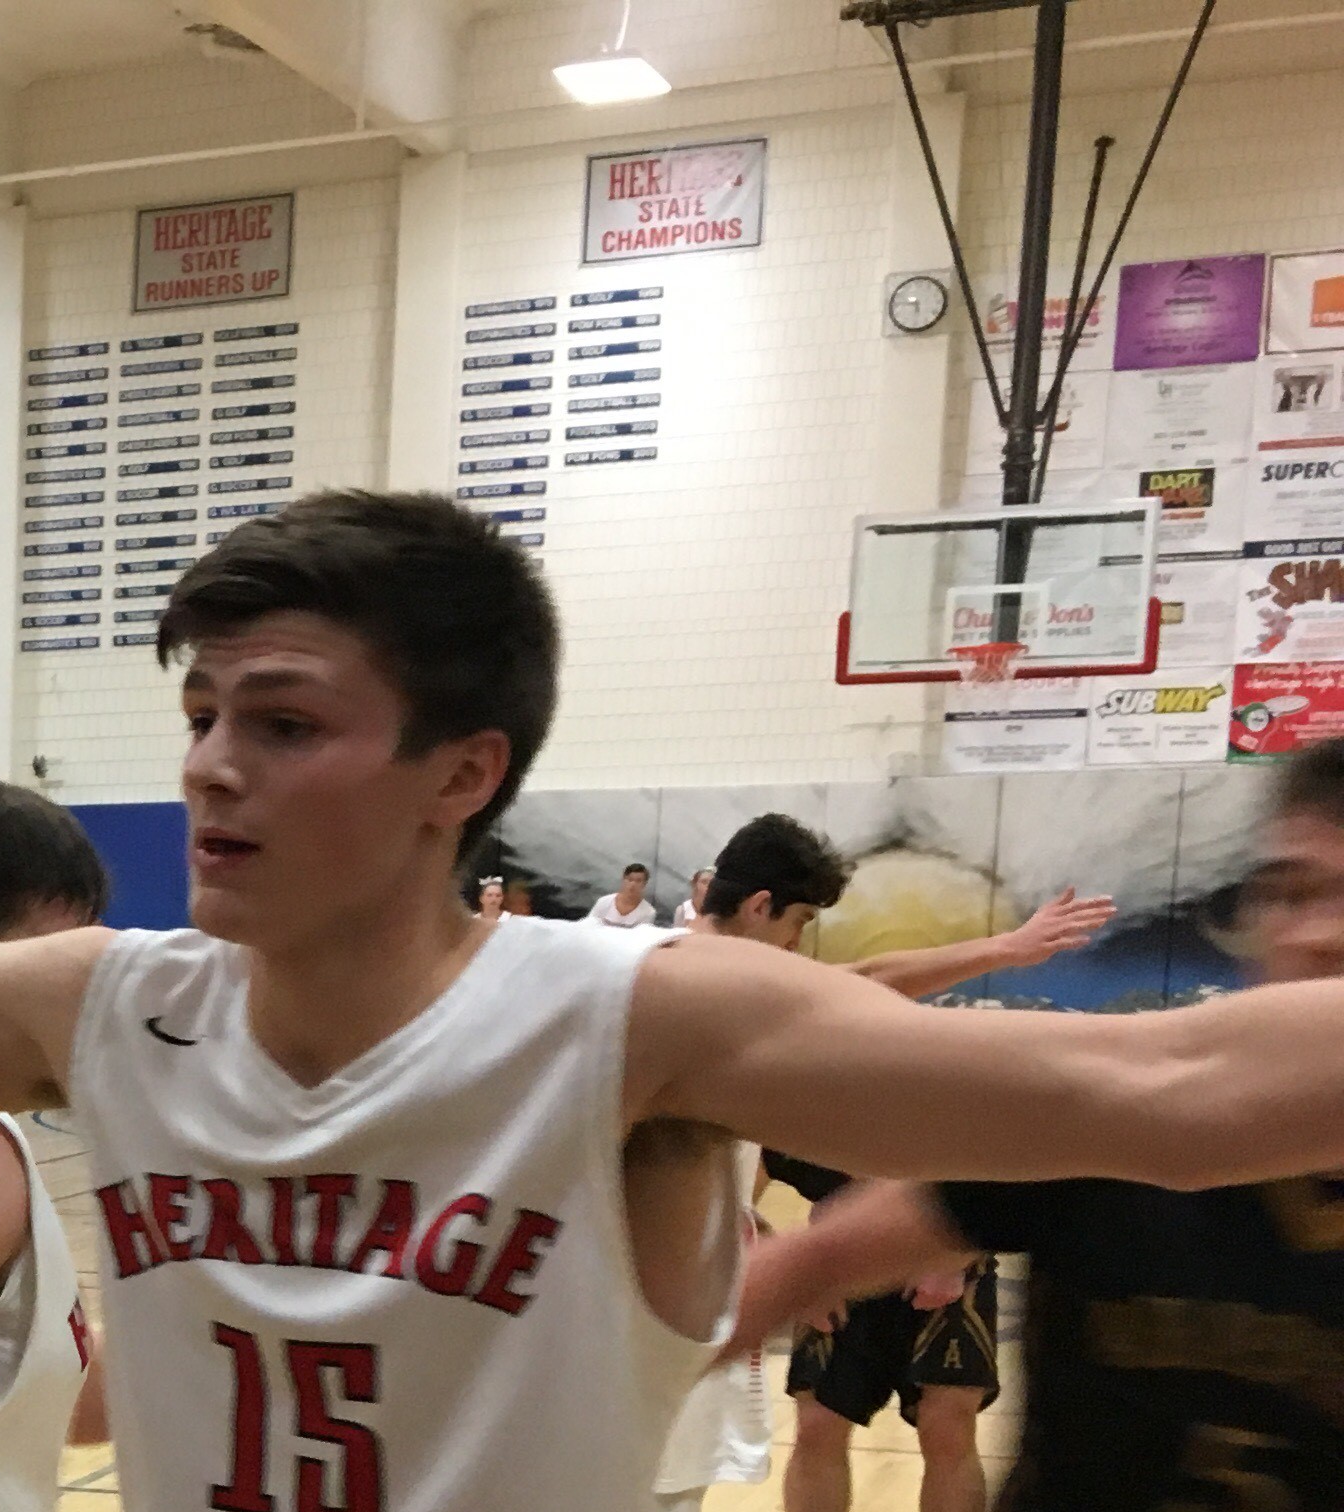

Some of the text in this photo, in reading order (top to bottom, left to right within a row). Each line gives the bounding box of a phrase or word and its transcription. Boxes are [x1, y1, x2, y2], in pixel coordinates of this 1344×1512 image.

[638, 195, 707, 223] STATE
[153, 204, 272, 251] HERITAGE
[601, 217, 742, 254] CHAMPIONS
[181, 249, 240, 274] STATE
[144, 269, 280, 303] RUNNERS UP
[1095, 683, 1227, 718] SUBWAY
[95, 1172, 565, 1318] HERITAGE
[942, 1338, 964, 1370] A
